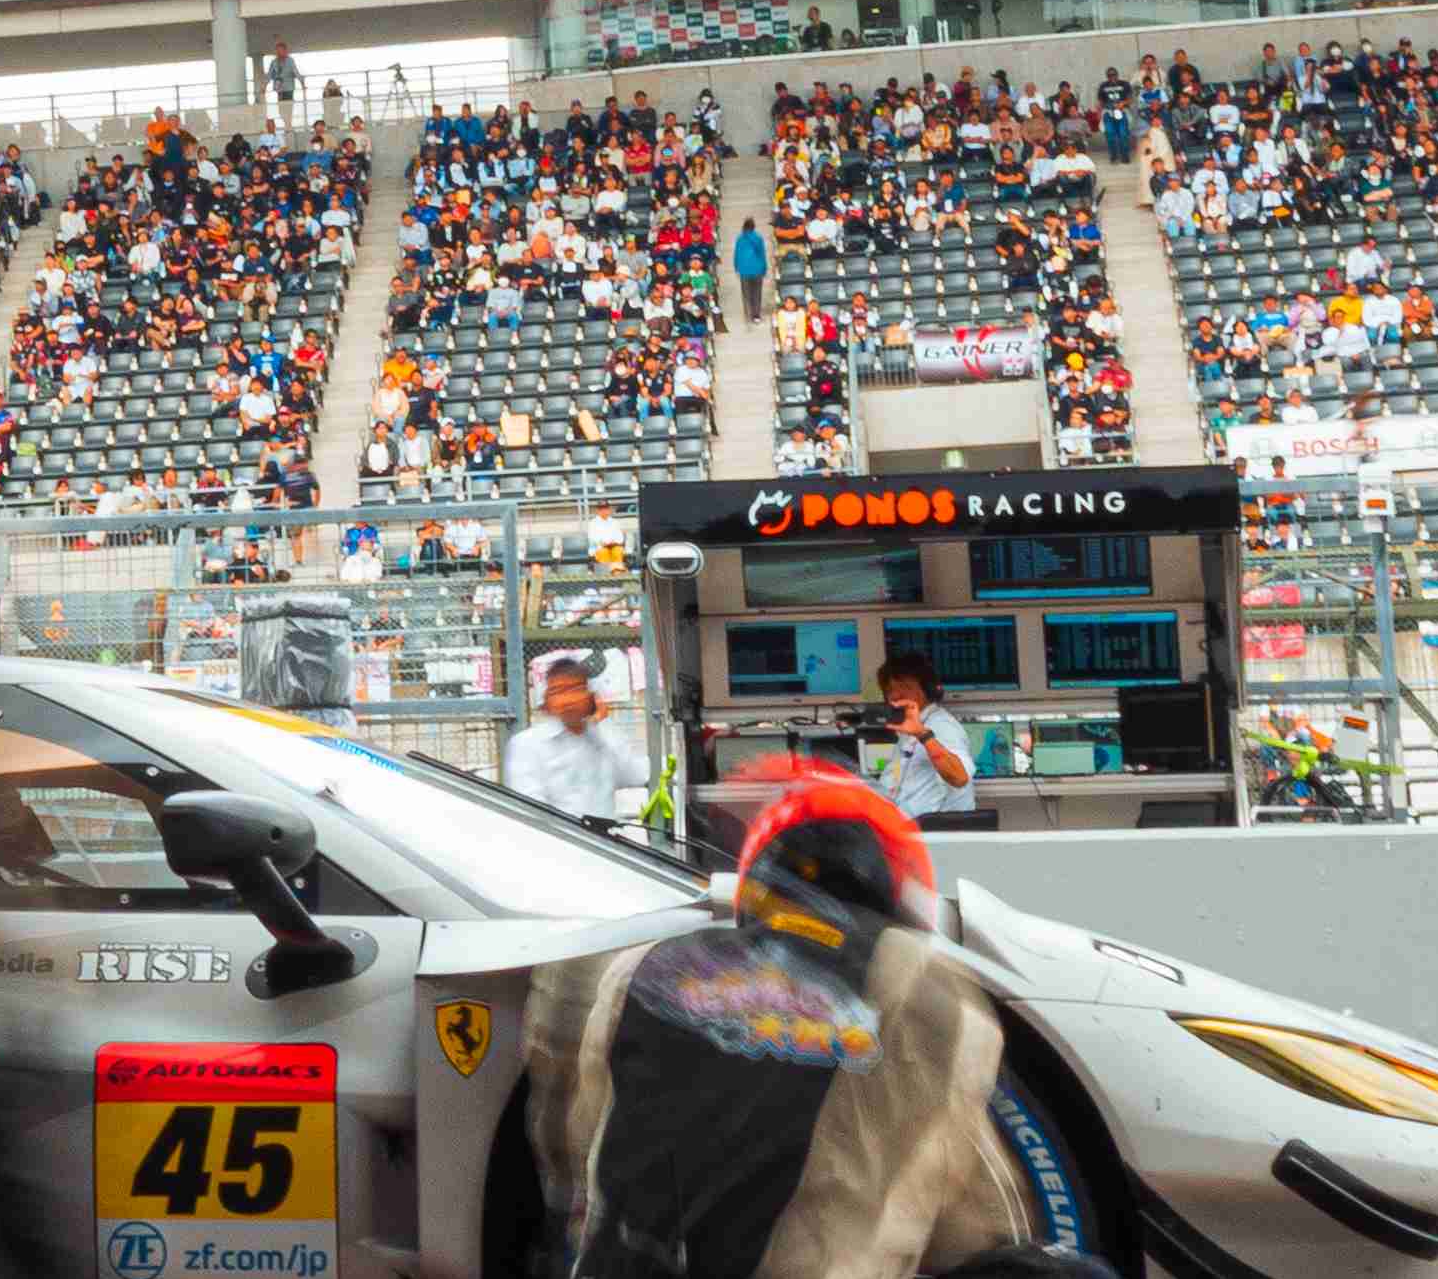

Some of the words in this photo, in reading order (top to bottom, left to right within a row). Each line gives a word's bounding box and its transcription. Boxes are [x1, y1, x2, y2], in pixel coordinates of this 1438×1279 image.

[924, 340, 1024, 360] GAINER
[802, 489, 956, 528] PONOS
[968, 491, 1126, 517] RACING
[76, 949, 231, 983] RISE
[146, 1062, 323, 1080] AUTOBACS
[131, 1105, 302, 1216] 45
[184, 1242, 328, 1277] zf.com/jp
